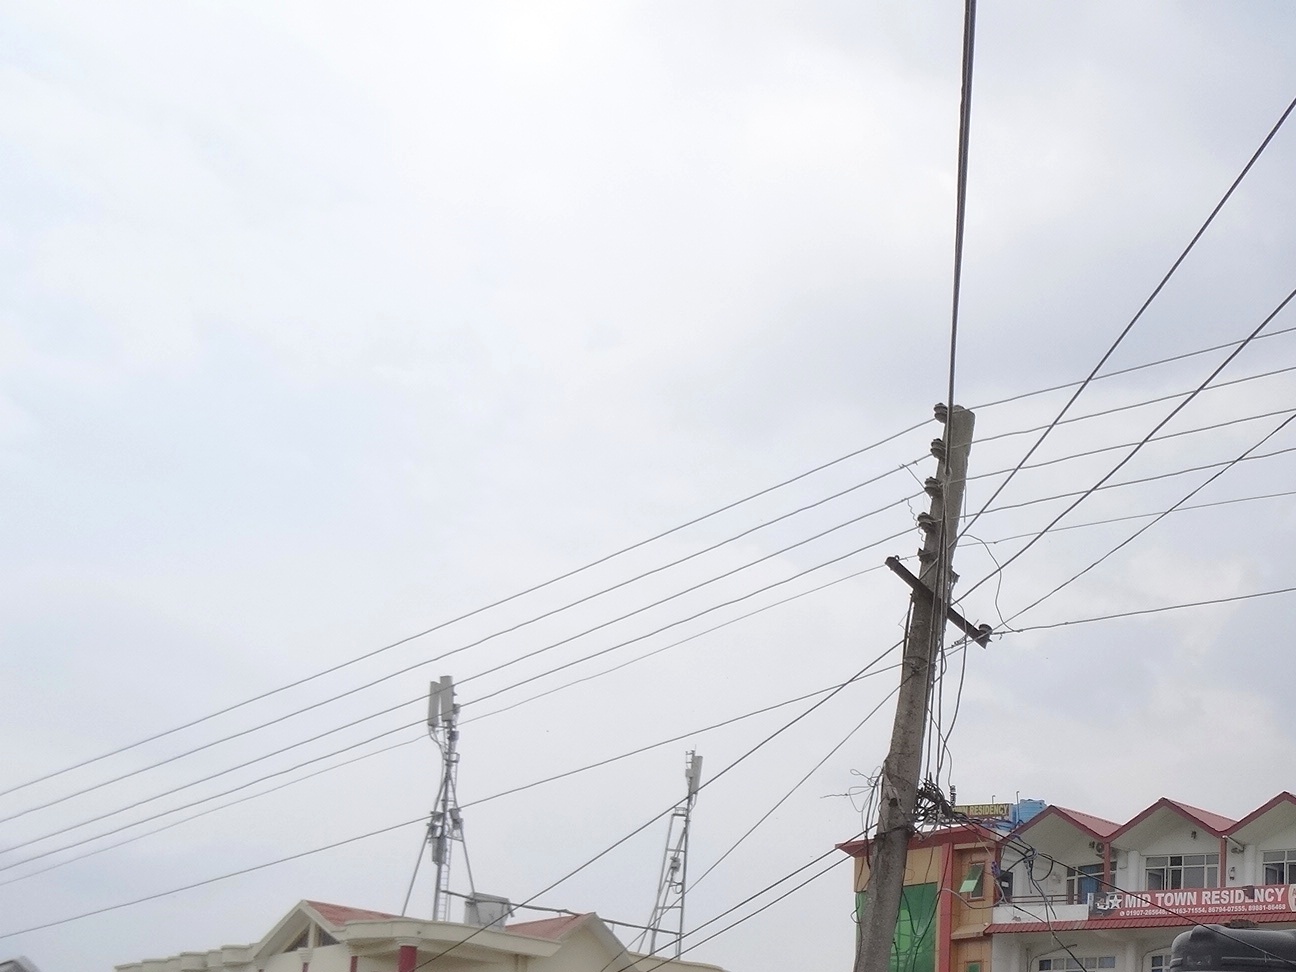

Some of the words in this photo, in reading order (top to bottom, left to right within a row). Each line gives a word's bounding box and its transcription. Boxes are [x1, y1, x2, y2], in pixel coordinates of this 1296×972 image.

[970, 804, 1009, 816] RESIDENCY
[1125, 893, 1152, 908] MID
[1155, 891, 1198, 907] TOWN
